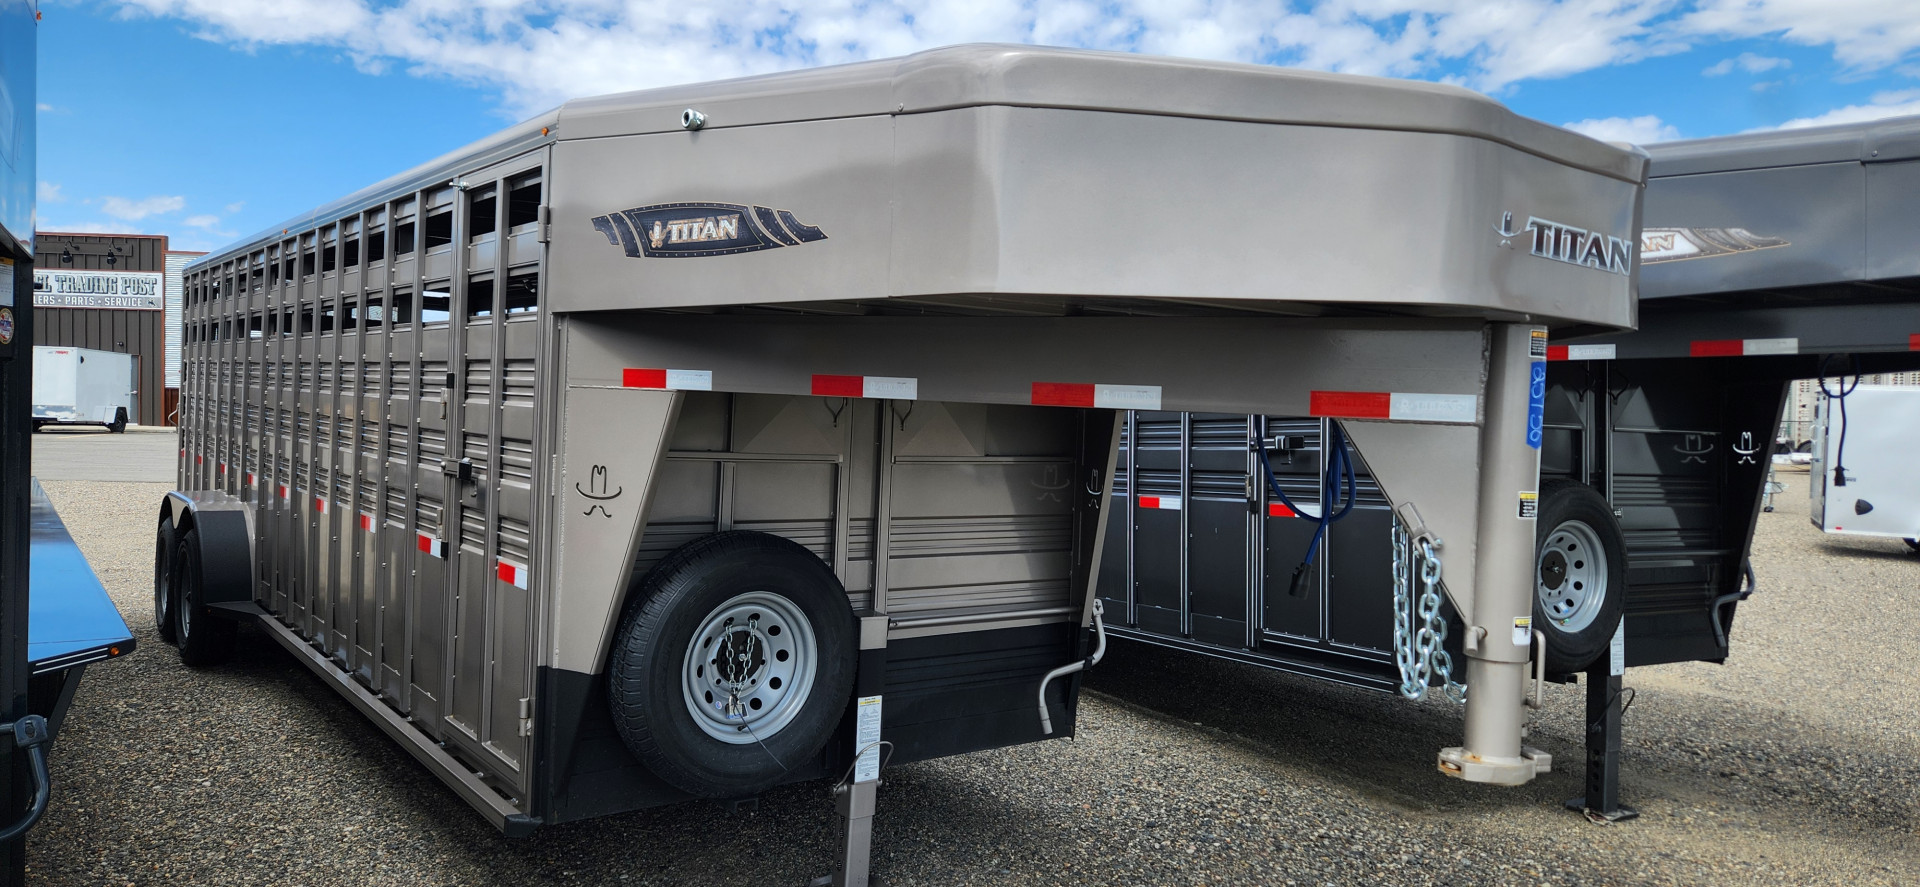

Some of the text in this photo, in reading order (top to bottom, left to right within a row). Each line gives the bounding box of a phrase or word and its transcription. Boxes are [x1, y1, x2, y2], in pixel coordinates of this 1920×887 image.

[669, 214, 739, 244] TITAN
[1525, 216, 1632, 276] TITAN
[55, 275, 118, 294] TRADING
[121, 277, 157, 295] POST
[65, 296, 95, 306] PARTS
[104, 297, 142, 307] SERVICE
